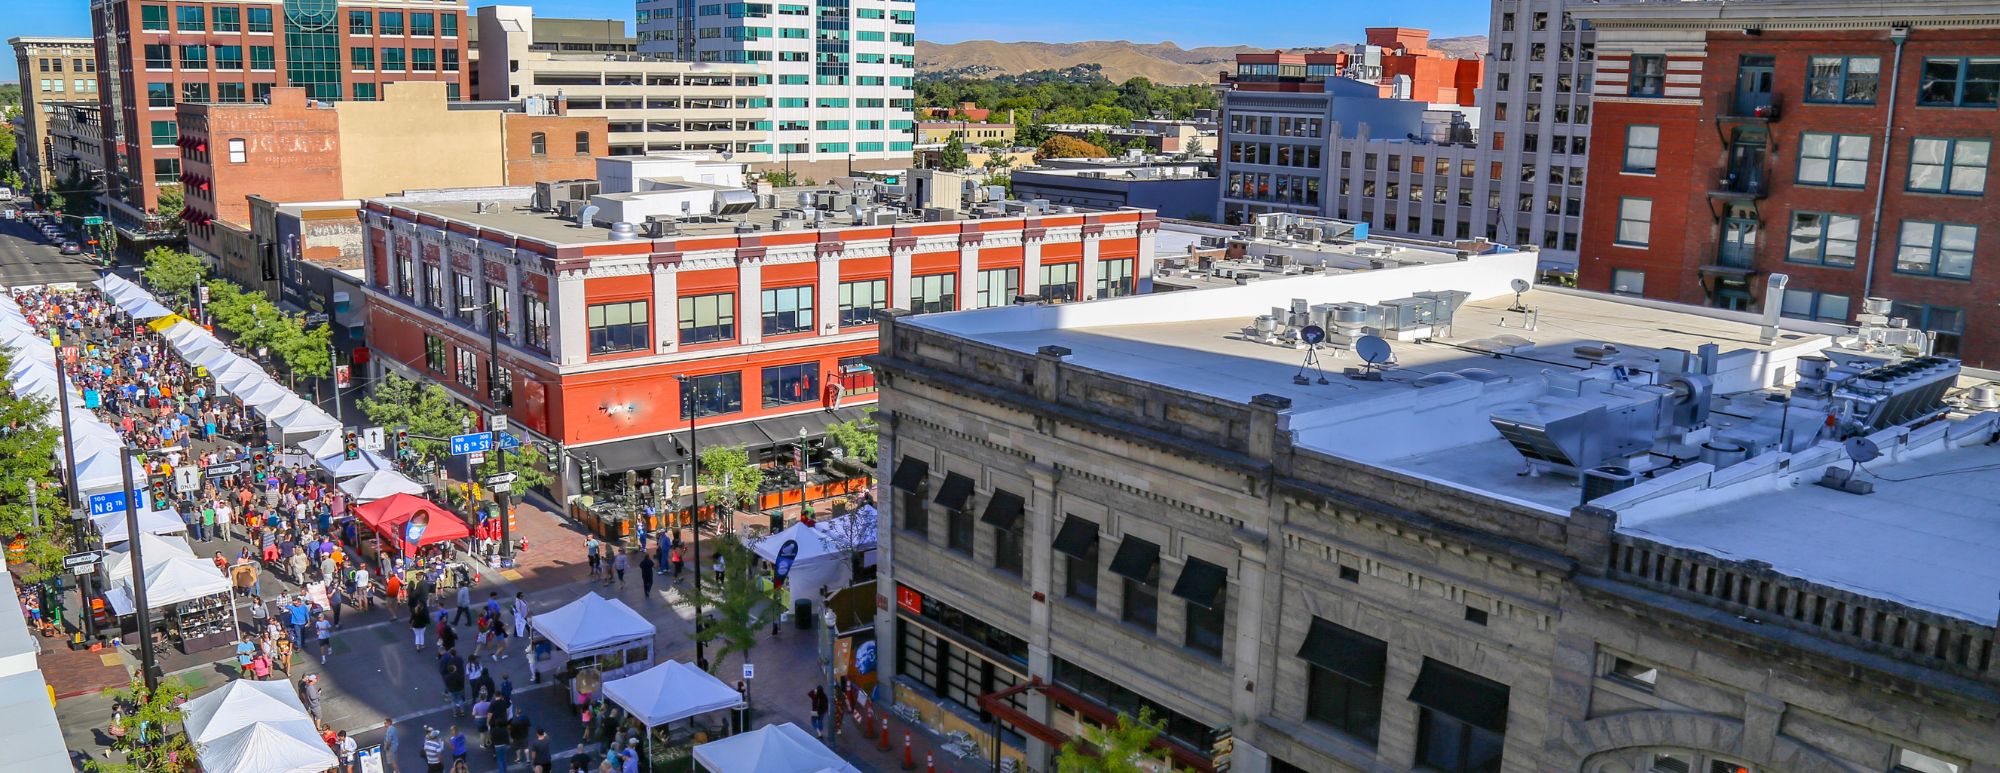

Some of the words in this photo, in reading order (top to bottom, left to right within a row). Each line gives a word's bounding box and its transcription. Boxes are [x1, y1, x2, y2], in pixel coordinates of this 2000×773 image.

[455, 444, 462, 453] N
[463, 443, 469, 452] 8
[479, 440, 489, 450] St
[879, 443, 889, 558] FIDELITY
[95, 503, 103, 513] N
[106, 502, 113, 512] 8
